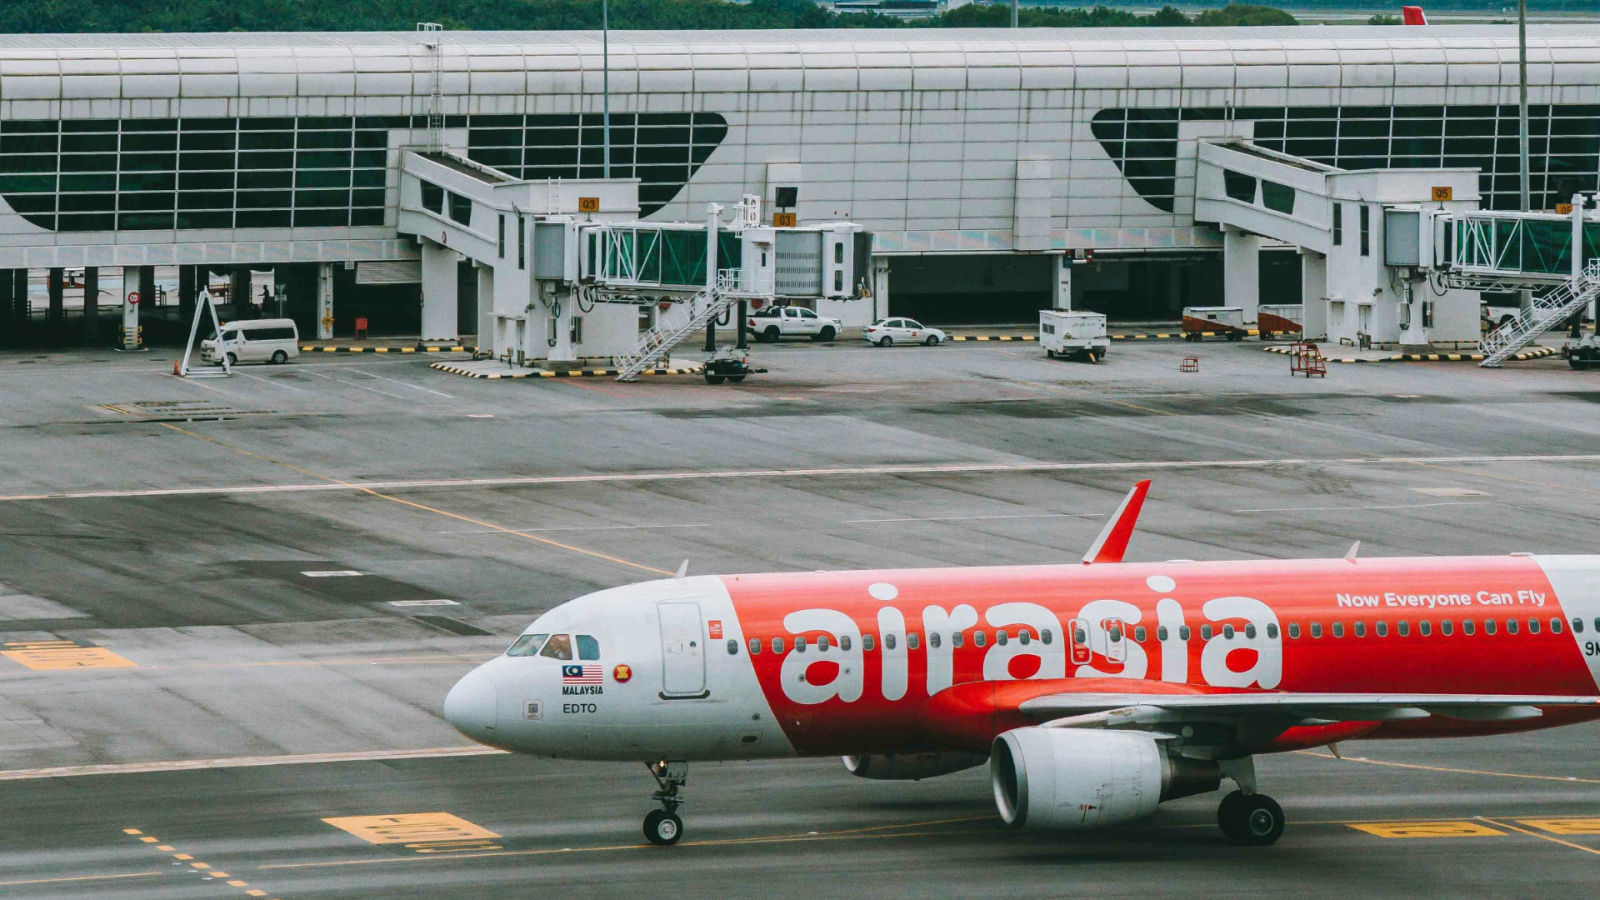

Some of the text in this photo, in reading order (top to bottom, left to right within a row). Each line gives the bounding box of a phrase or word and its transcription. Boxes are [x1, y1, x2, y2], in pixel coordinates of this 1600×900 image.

[582, 199, 596, 210] Q3
[1336, 590, 1546, 608] Now Everyone Can Fly
[780, 575, 1283, 705] airasia
[562, 685, 603, 695] MALAYSIA
[563, 703, 597, 713] EDTO
